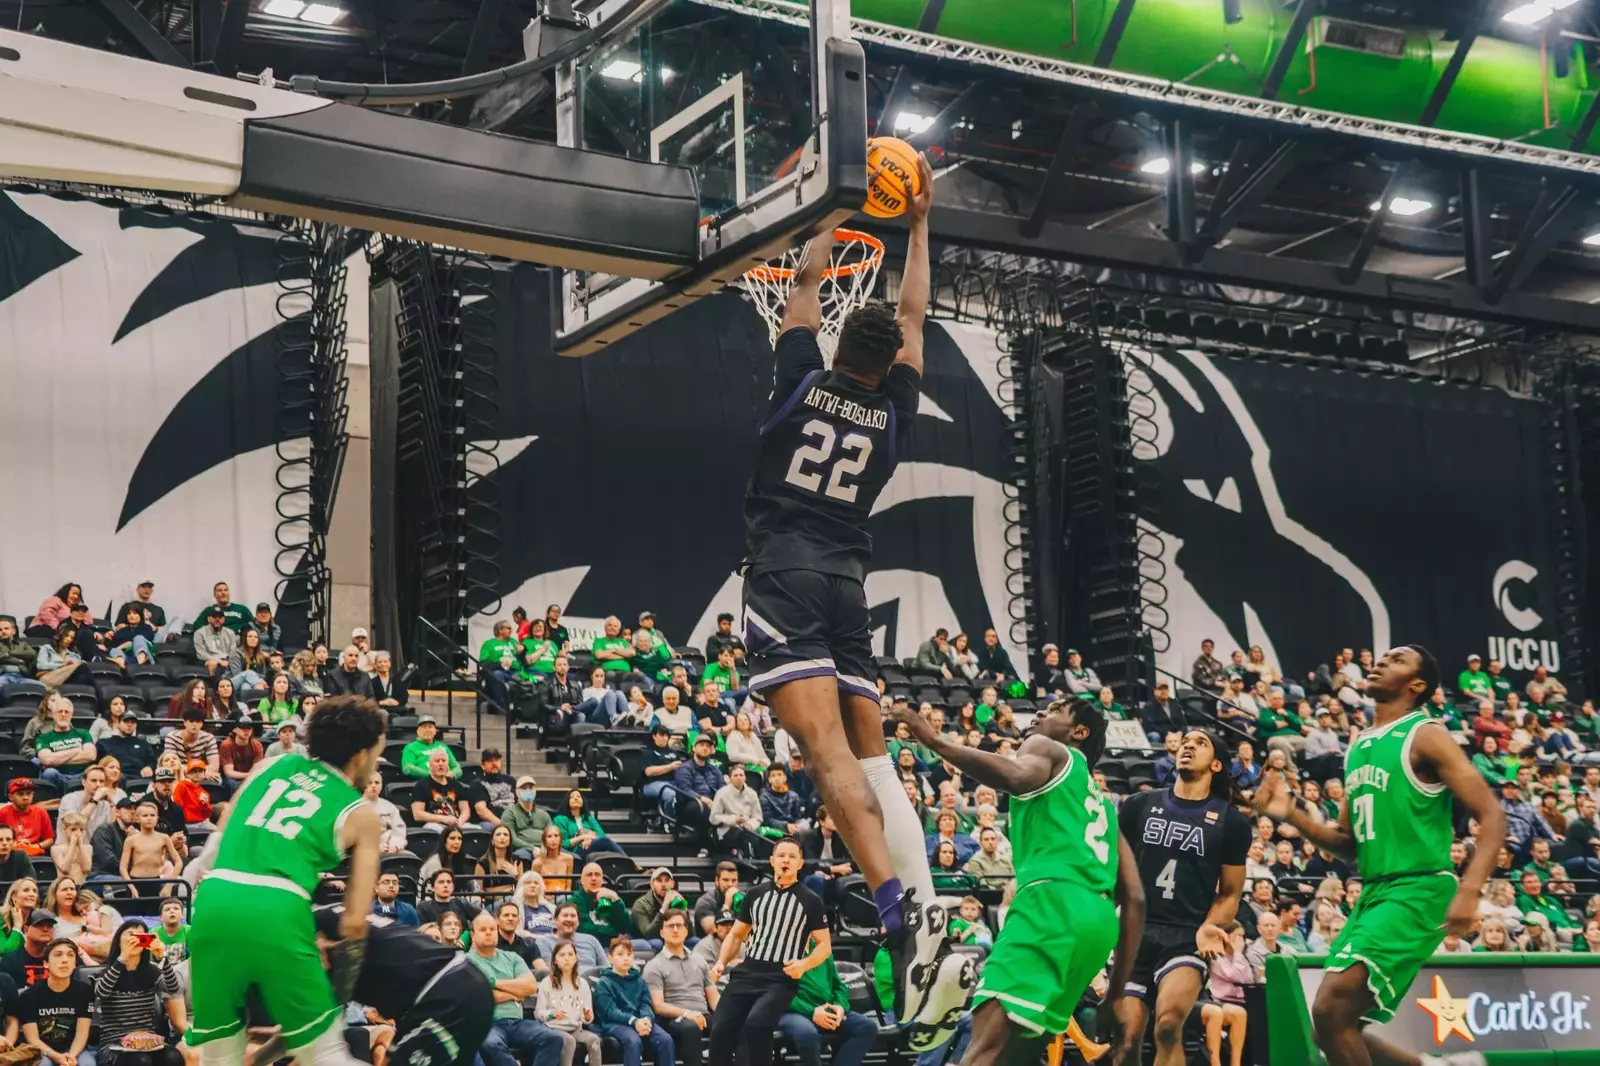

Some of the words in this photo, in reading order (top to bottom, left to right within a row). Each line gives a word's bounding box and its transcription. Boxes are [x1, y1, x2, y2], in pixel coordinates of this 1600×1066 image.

[784, 418, 873, 503] 22
[1487, 635, 1560, 673] UCCU
[243, 778, 322, 841] 12
[1352, 793, 1376, 843] 21
[1142, 816, 1205, 857] SFA
[1155, 858, 1178, 900] 4
[38, 1007, 58, 1016] UVU
[1466, 989, 1548, 1035] Carl's
[1549, 991, 1592, 1035] Jr.
